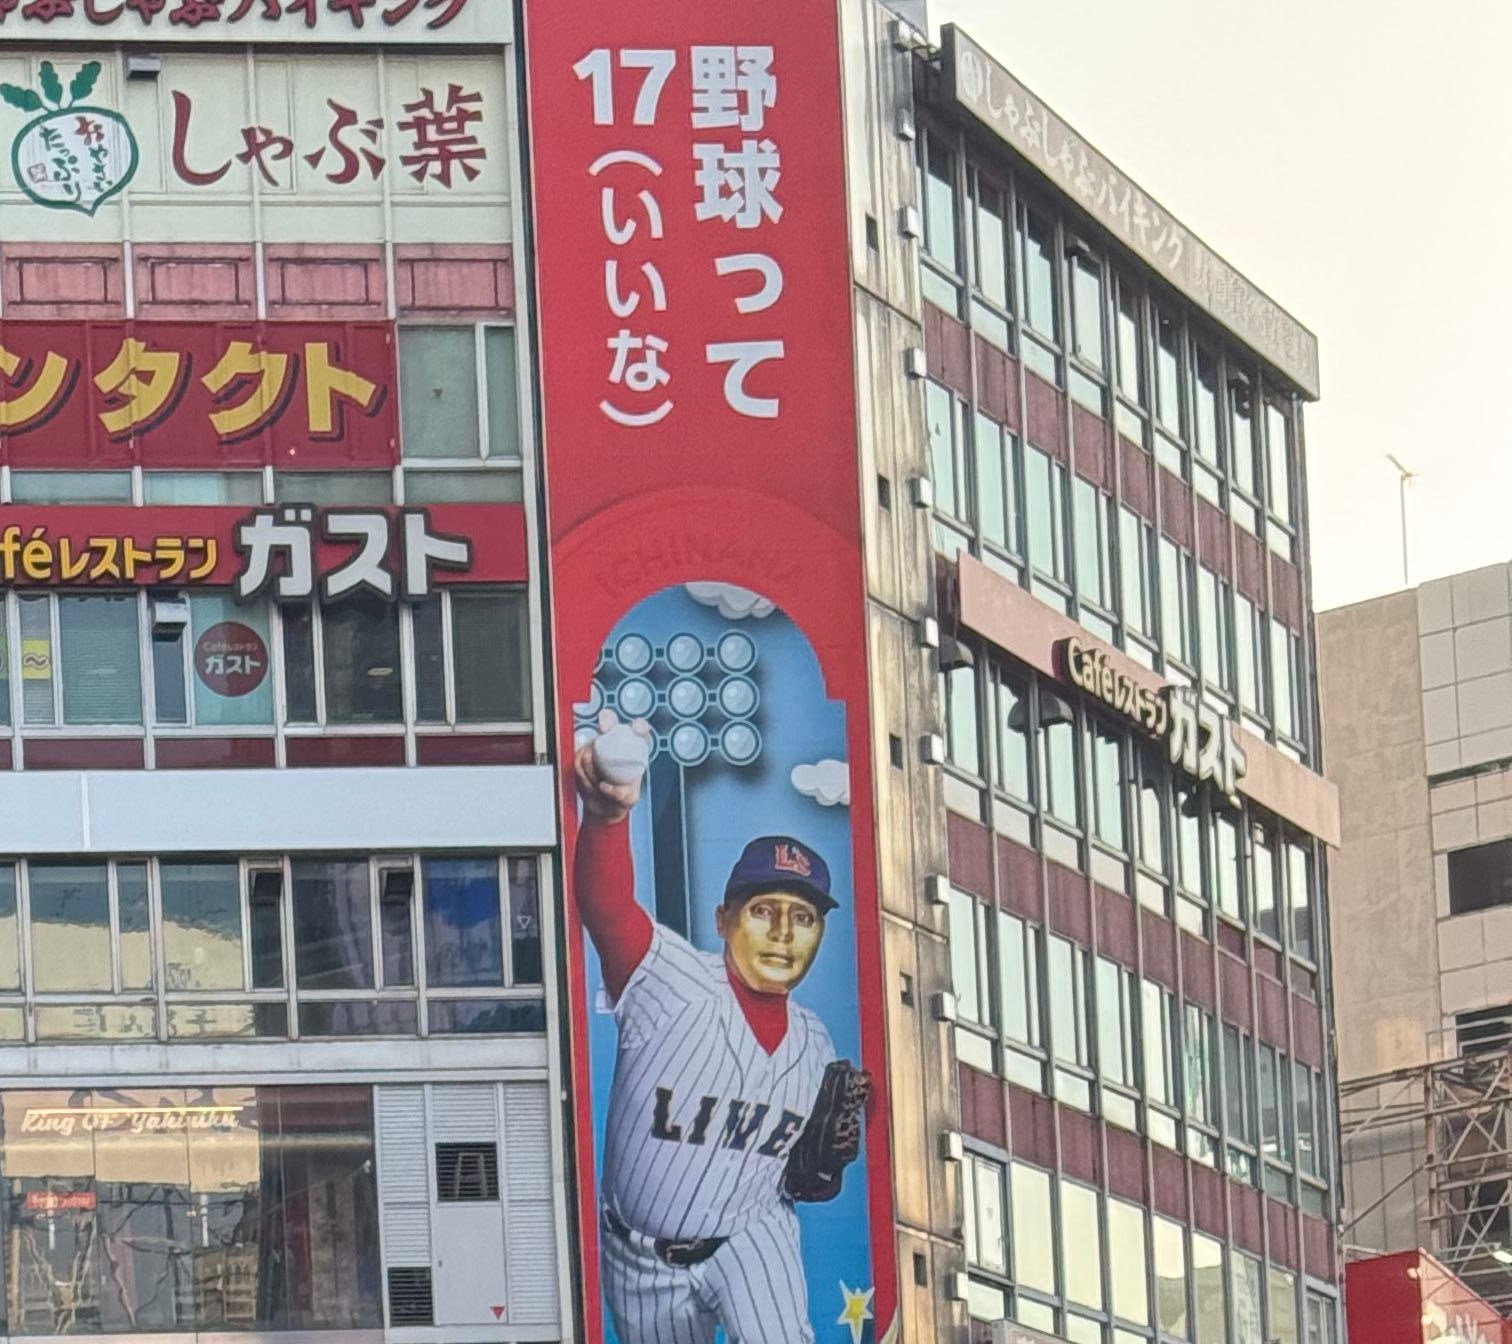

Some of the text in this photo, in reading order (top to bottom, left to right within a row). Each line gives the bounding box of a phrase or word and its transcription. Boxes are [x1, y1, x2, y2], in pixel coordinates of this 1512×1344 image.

[172, 84, 488, 188] しゃぶ葉
[690, 45, 785, 418] 野球って
[239, 507, 471, 599] ガスト
[205, 654, 262, 675] ガスト
[1168, 685, 1247, 797] ガスト
[650, 1086, 805, 1160] LIVE
